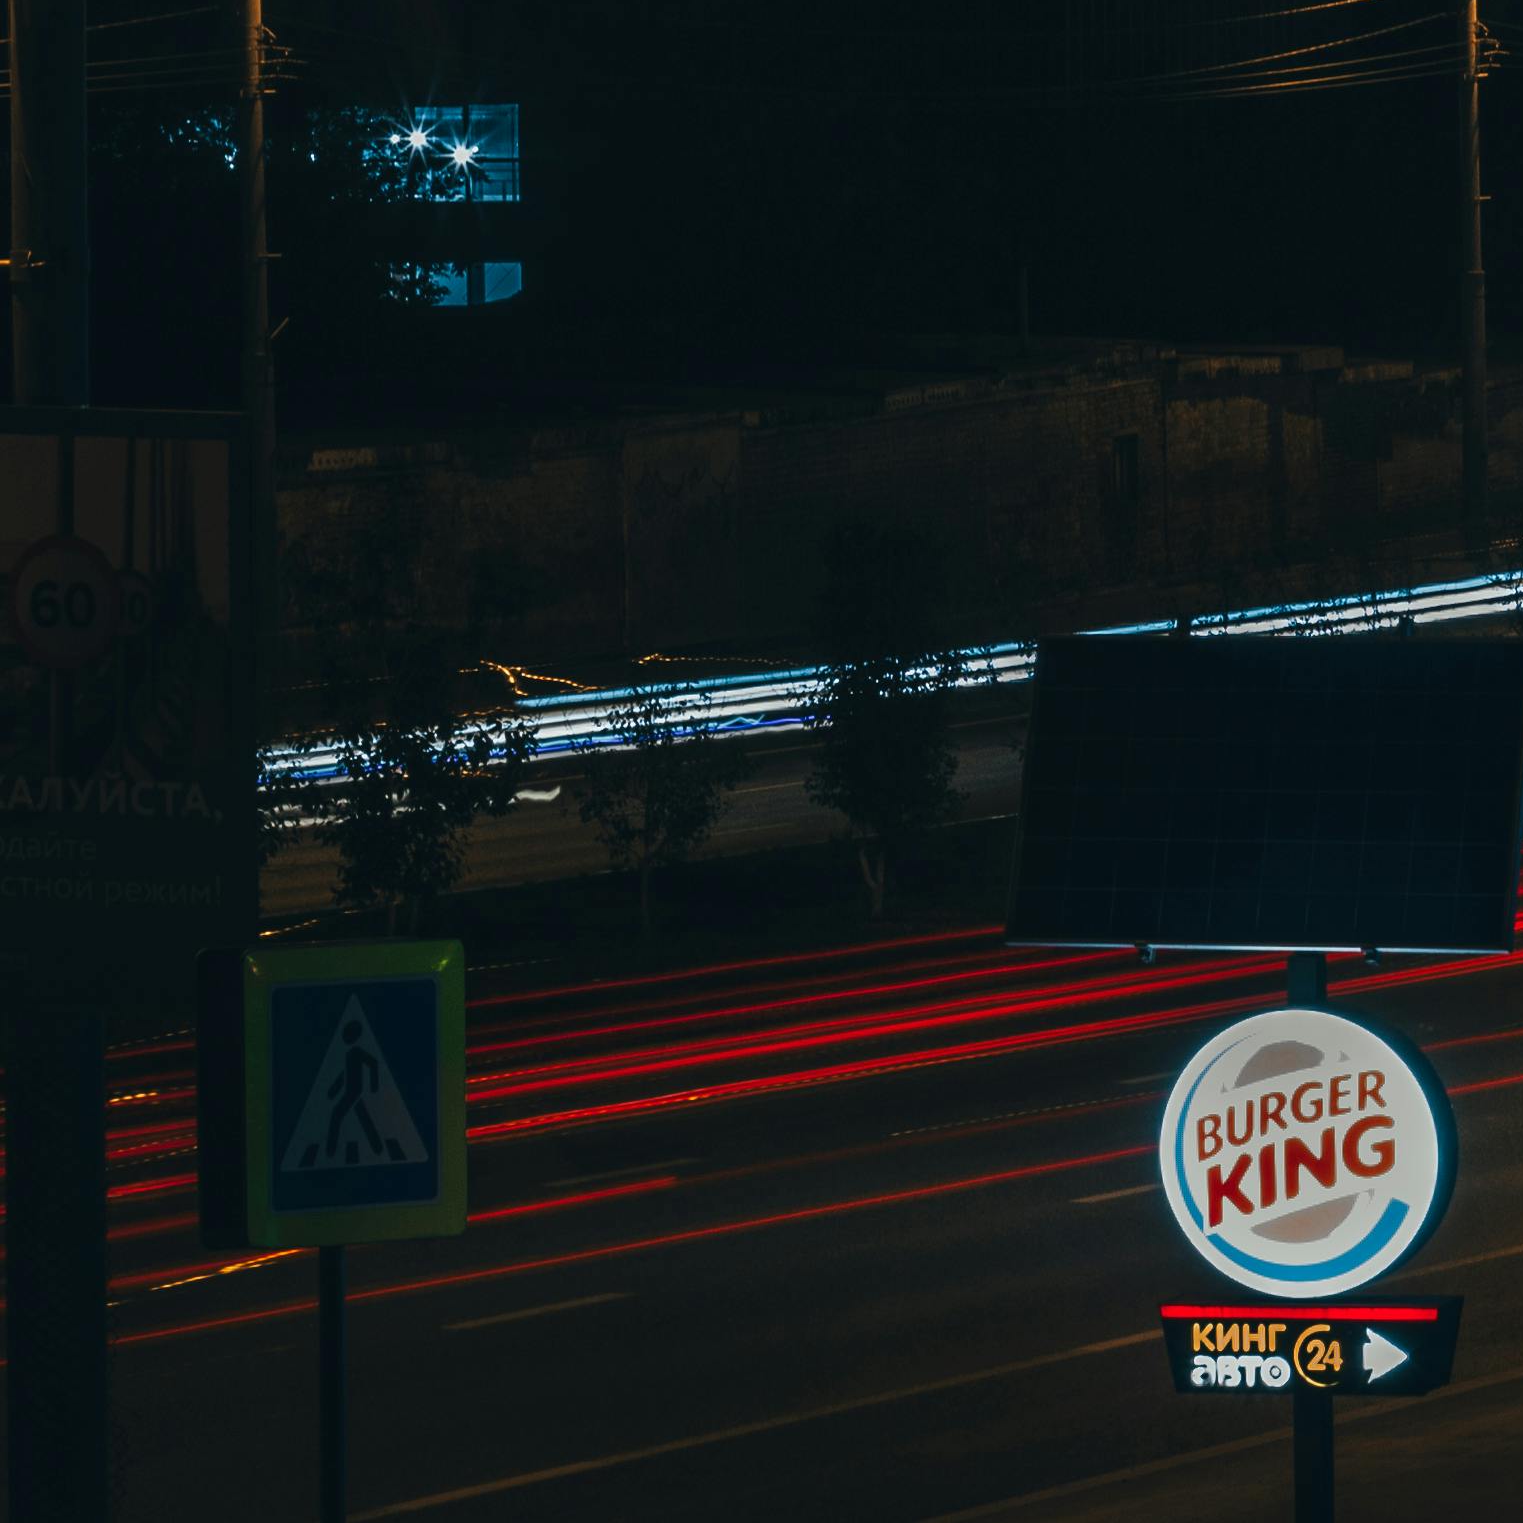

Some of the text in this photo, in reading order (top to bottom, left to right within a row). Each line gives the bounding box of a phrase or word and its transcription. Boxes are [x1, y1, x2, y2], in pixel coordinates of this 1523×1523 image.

[30, 579, 97, 629] 60
[1197, 1069, 1387, 1162] BURGER
[1206, 1115, 1396, 1229] KING
[1191, 1322, 1287, 1353] КИНГ
[1305, 1337, 1344, 1372] 24
